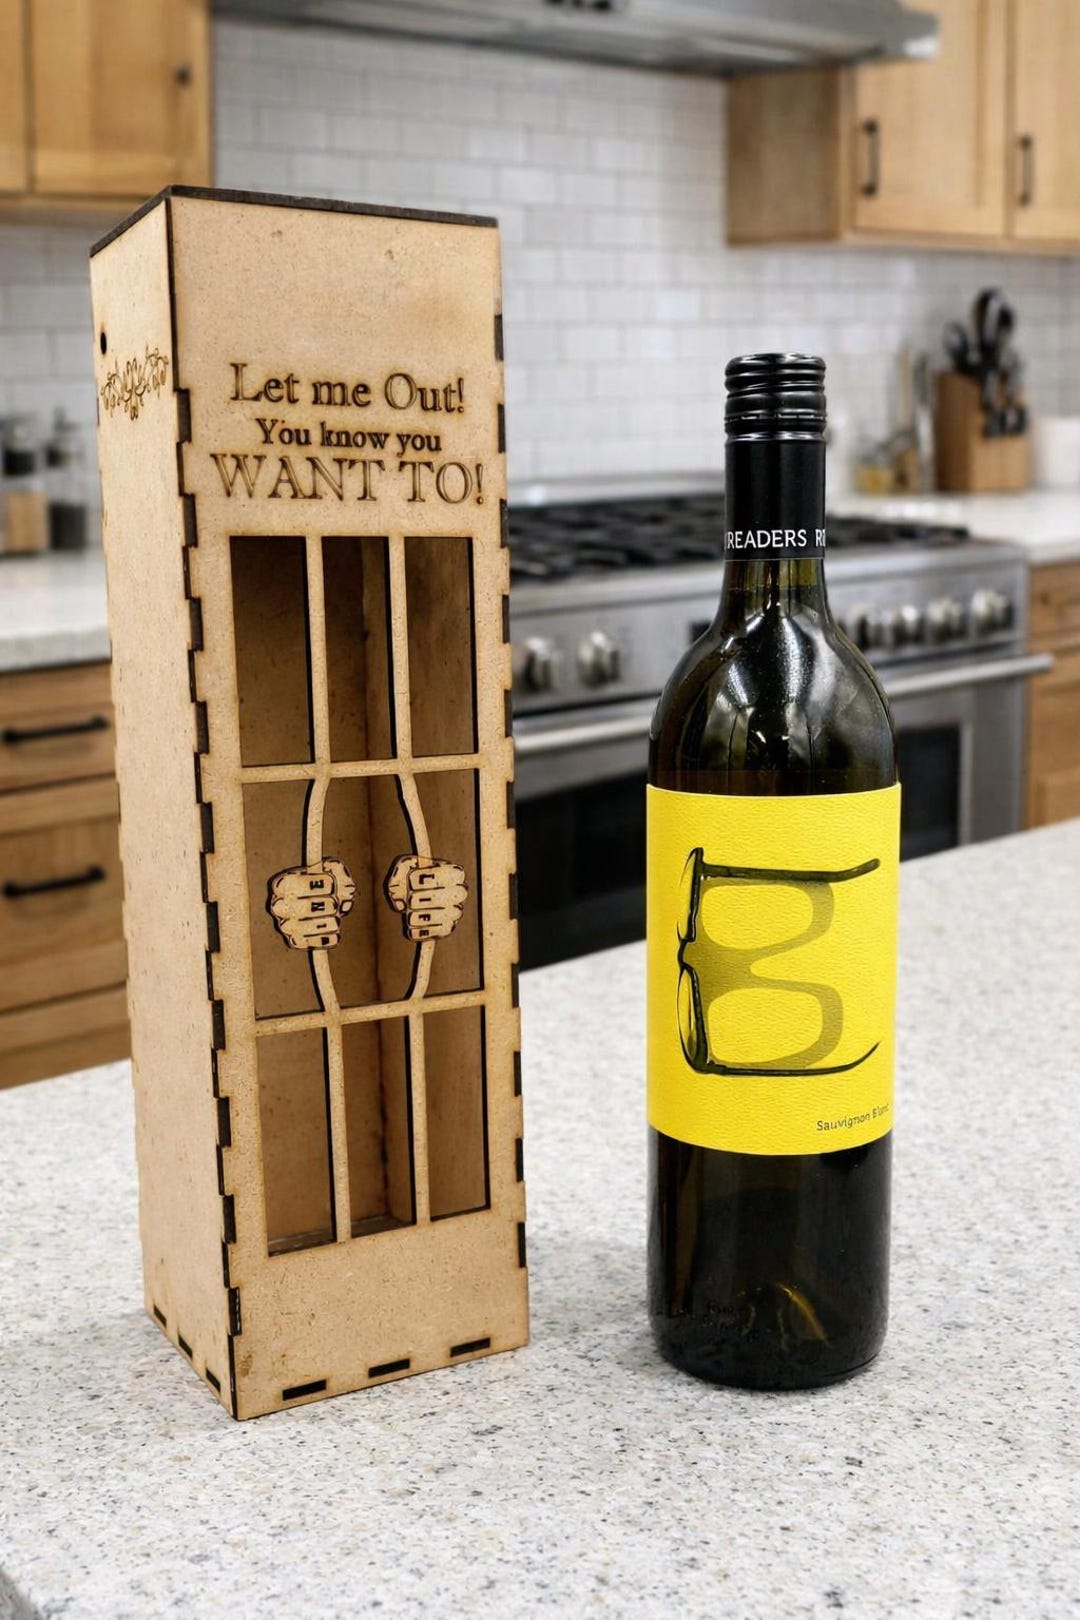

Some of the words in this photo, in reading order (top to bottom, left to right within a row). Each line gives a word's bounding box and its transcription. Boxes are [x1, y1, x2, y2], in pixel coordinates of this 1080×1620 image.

[230, 362, 300, 403] Let
[312, 380, 371, 407] me
[384, 372, 465, 413] Out!
[255, 418, 312, 446] You
[320, 421, 390, 450] know
[396, 431, 442, 458] you
[210, 453, 386, 501] WANT
[398, 460, 484, 505] TO!
[727, 529, 807, 549] READERS
[816, 1113, 871, 1131] Sauvignon
